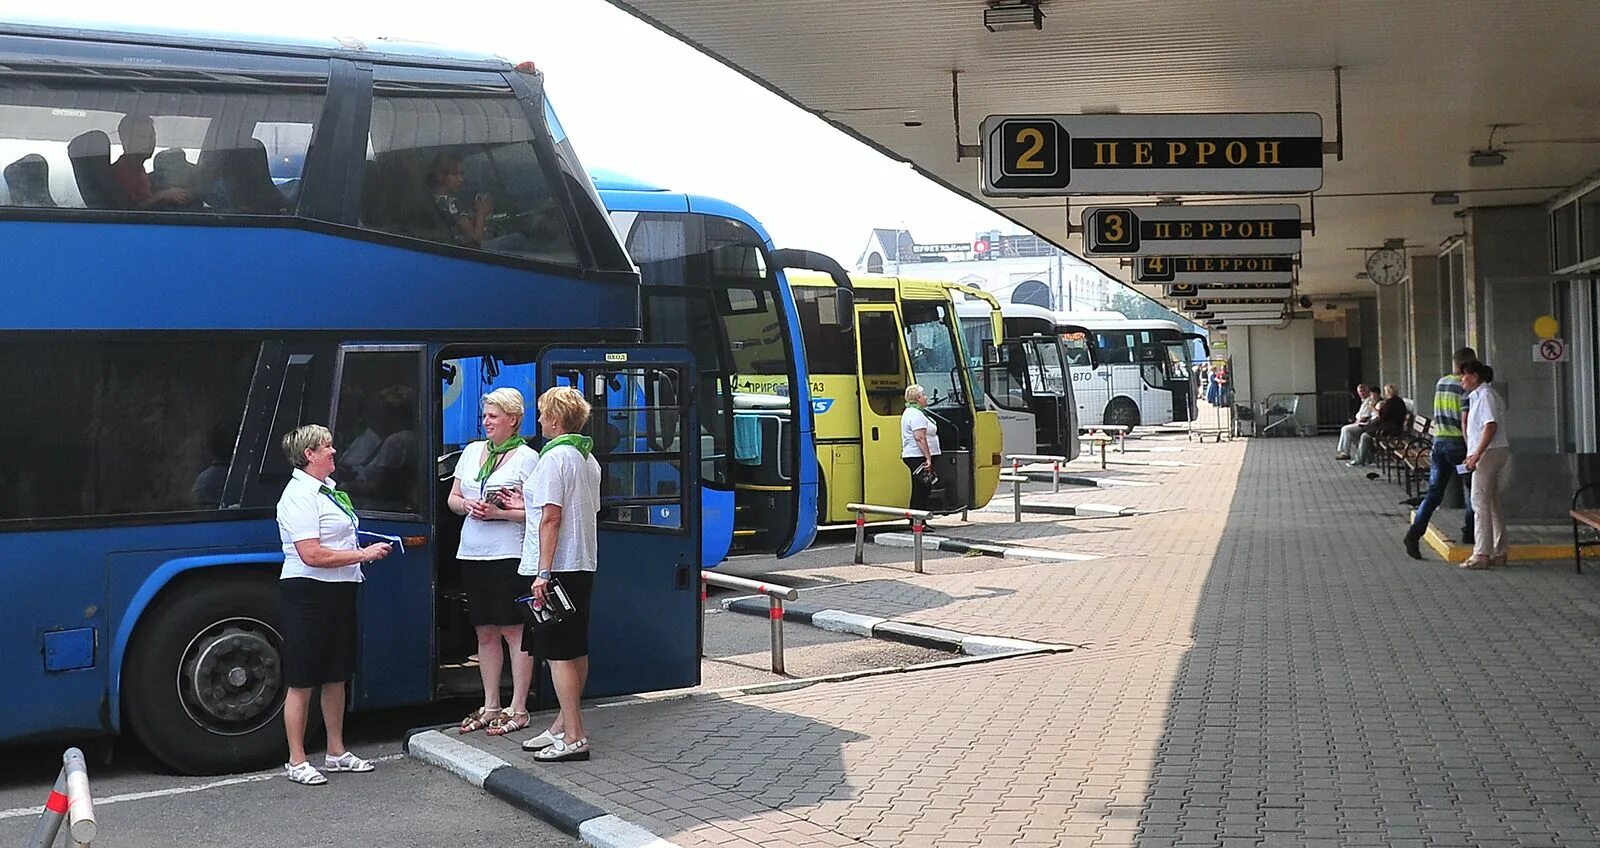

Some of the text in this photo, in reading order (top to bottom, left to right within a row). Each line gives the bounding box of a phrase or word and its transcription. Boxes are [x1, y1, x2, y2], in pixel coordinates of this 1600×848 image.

[1015, 128, 1281, 169] 2 ПЕРРОН
[1104, 214, 1275, 242] 3 ПЕРРОН
[1148, 257, 1274, 273] 4 ПЕРРОН
